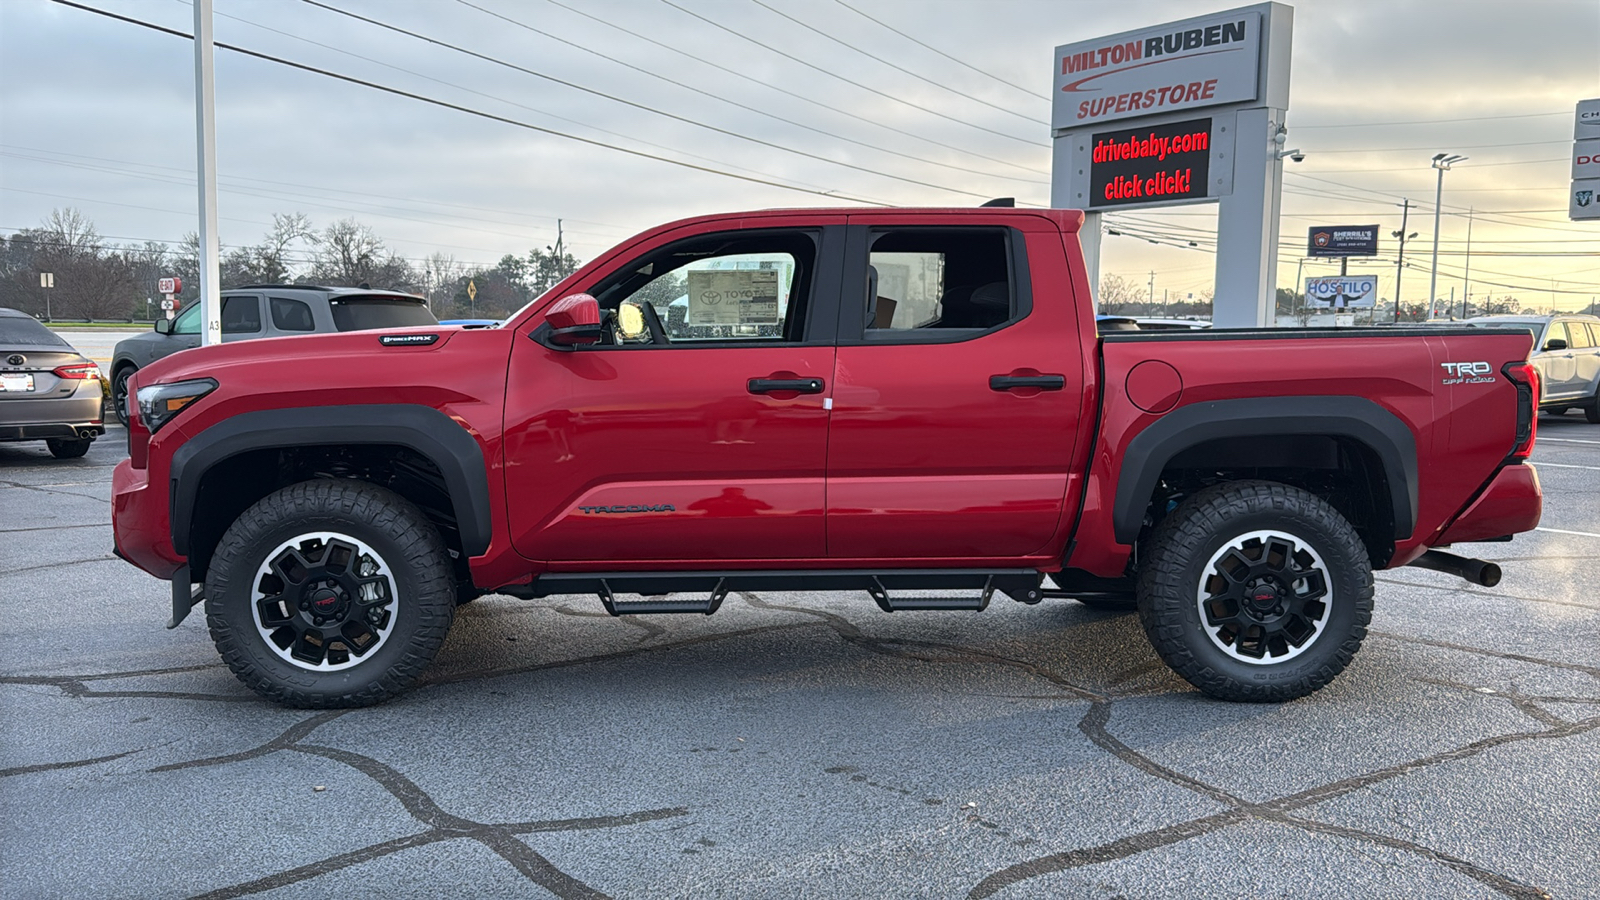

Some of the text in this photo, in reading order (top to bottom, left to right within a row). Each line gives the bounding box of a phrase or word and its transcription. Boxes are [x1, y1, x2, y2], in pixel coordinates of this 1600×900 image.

[1062, 21, 1245, 75] MILTON RUBEN
[1077, 79, 1218, 119] SUPERSTORE
[1093, 131, 1208, 164] drivebaby.com
[1105, 168, 1191, 200] click click!
[723, 290, 767, 298] TOYOTA
[1308, 282, 1372, 293] HOSTILO
[209, 320, 220, 331] A3
[1441, 362, 1492, 377] TRD
[578, 504, 675, 514] TACOMA
